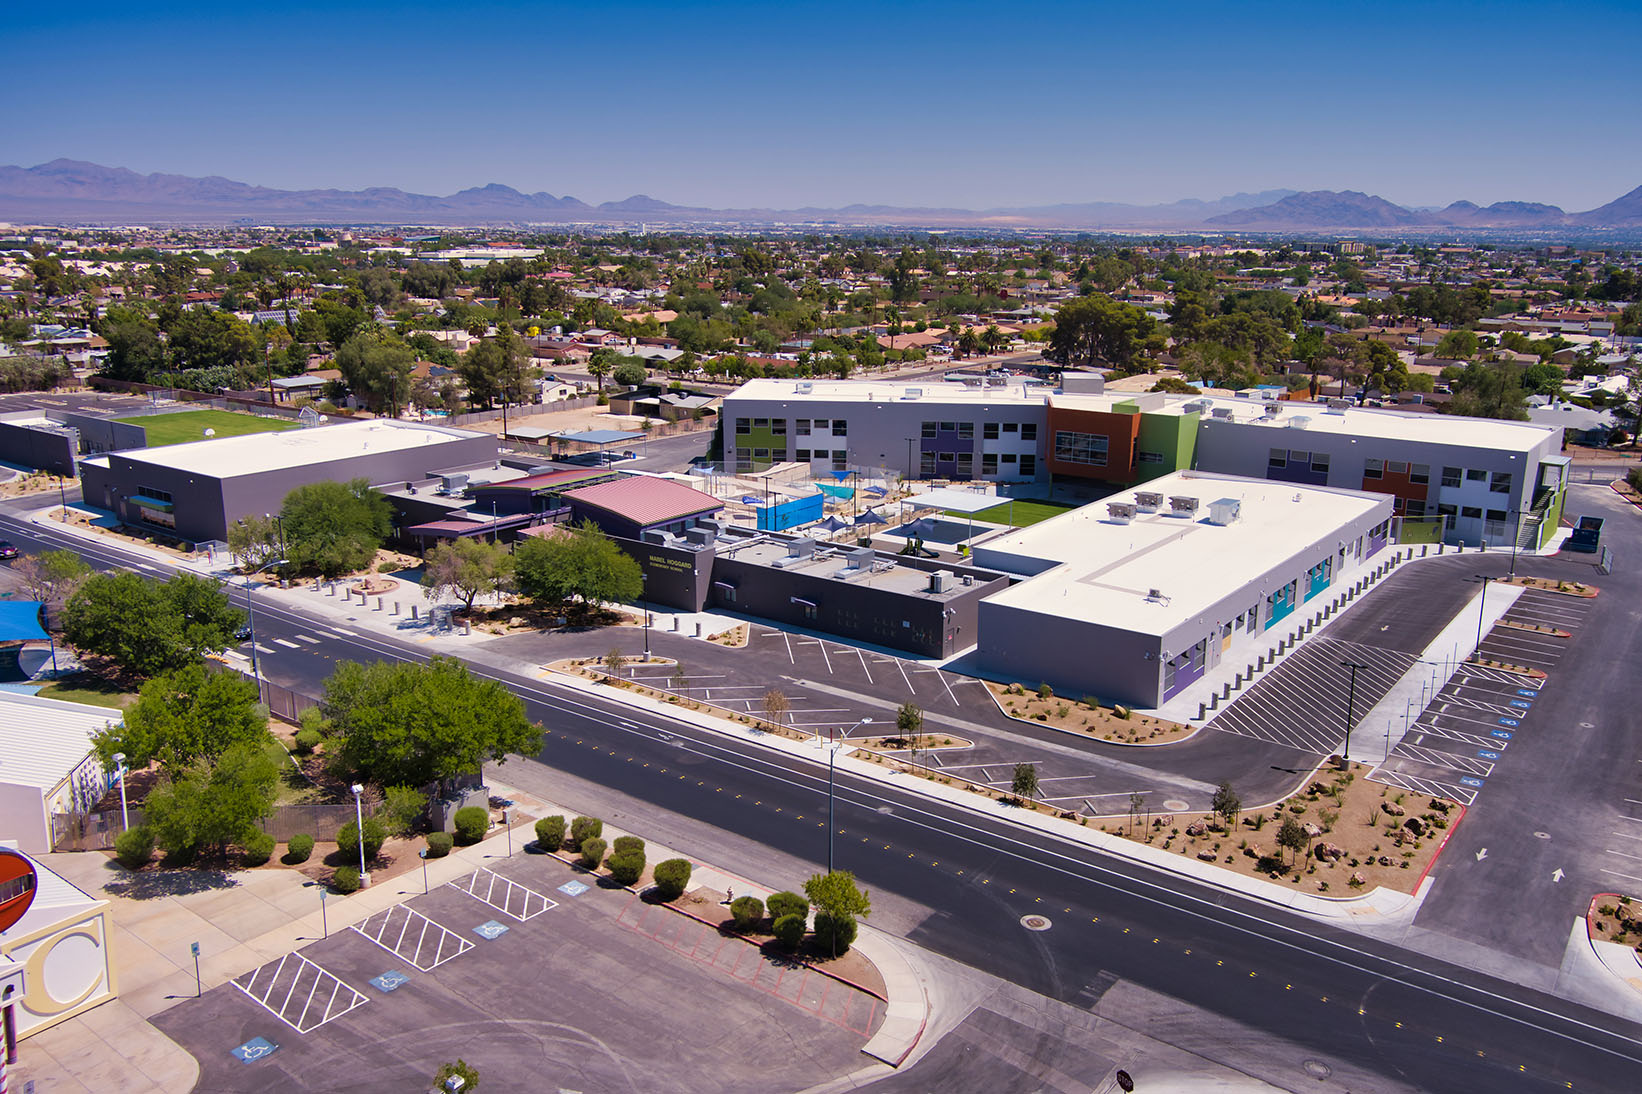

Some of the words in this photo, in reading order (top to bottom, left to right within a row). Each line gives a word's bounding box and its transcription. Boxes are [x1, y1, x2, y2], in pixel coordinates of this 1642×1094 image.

[649, 555, 666, 564] MABEL
[666, 559, 692, 569] HOGGARD
[20, 918, 104, 1017] C
[1118, 1073, 1132, 1087] STOP
